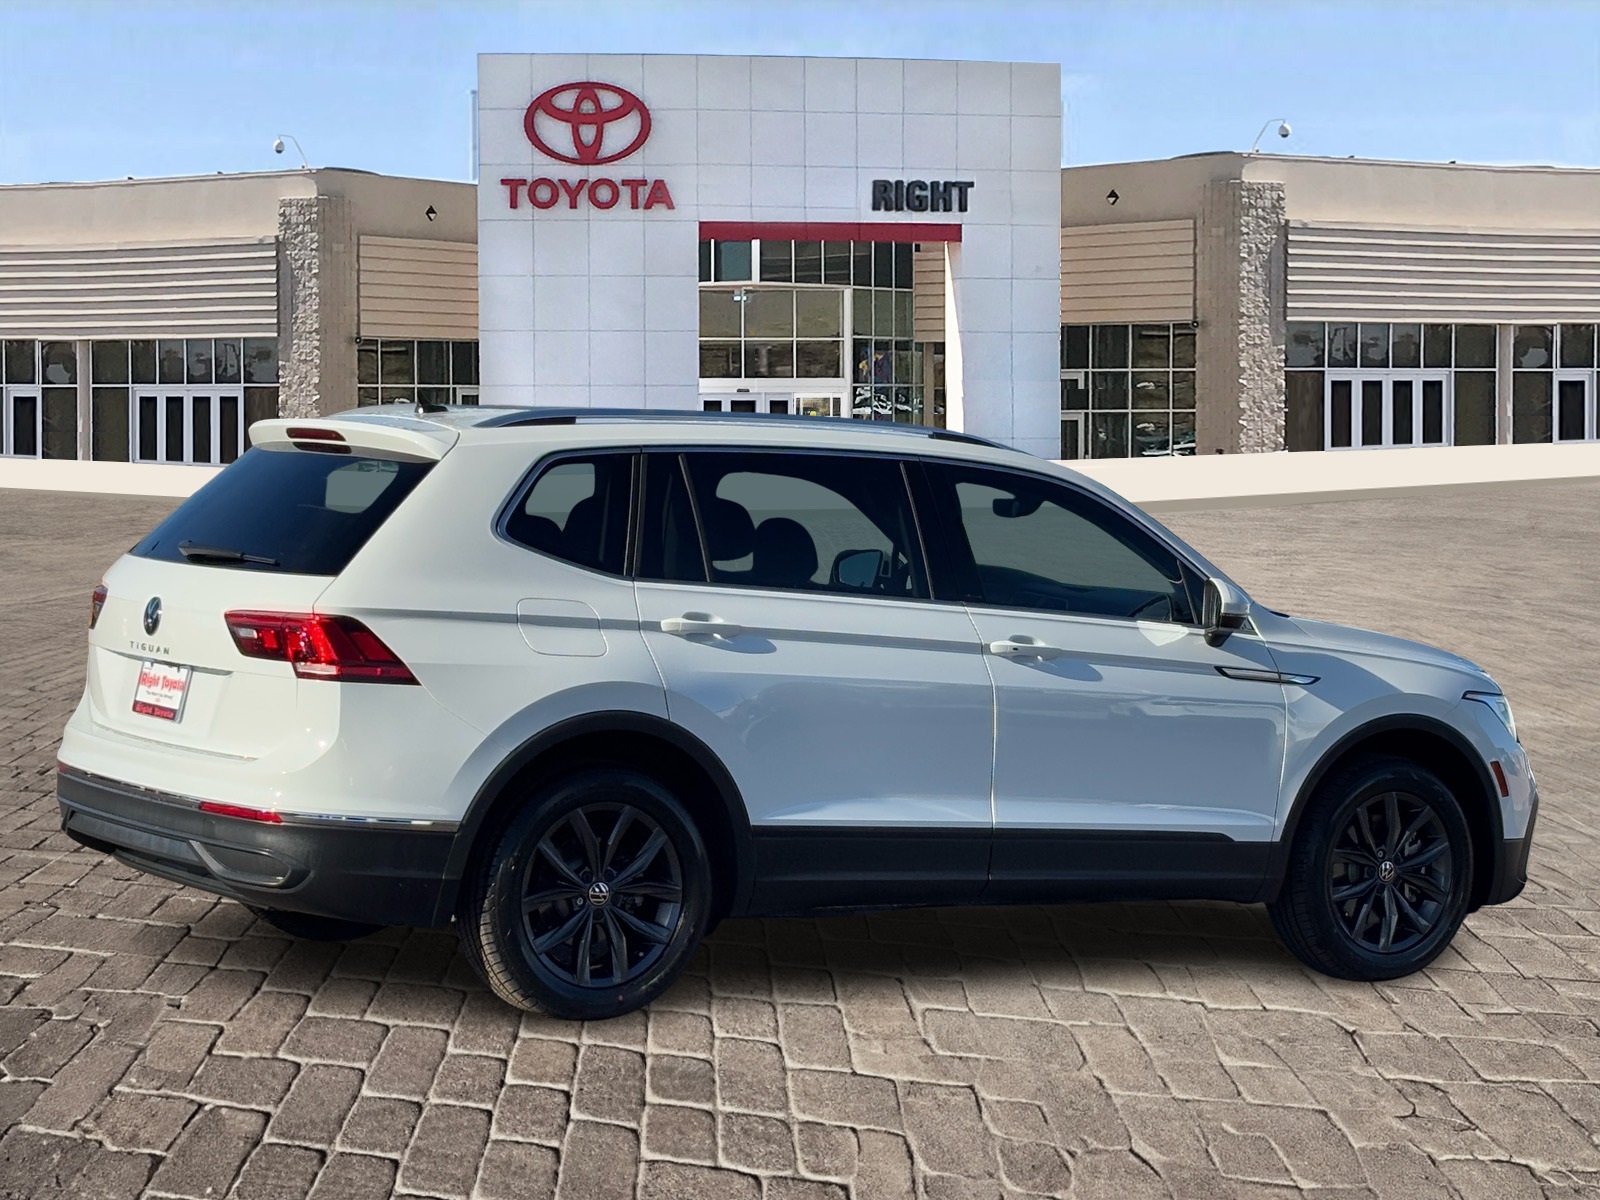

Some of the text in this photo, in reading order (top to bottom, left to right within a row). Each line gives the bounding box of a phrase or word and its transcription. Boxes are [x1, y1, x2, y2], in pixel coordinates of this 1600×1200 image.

[500, 178, 675, 210] TOYOTA
[871, 179, 975, 212] RIGHT
[130, 641, 170, 654] TIGUAN
[140, 672, 185, 692] Right Toyota
